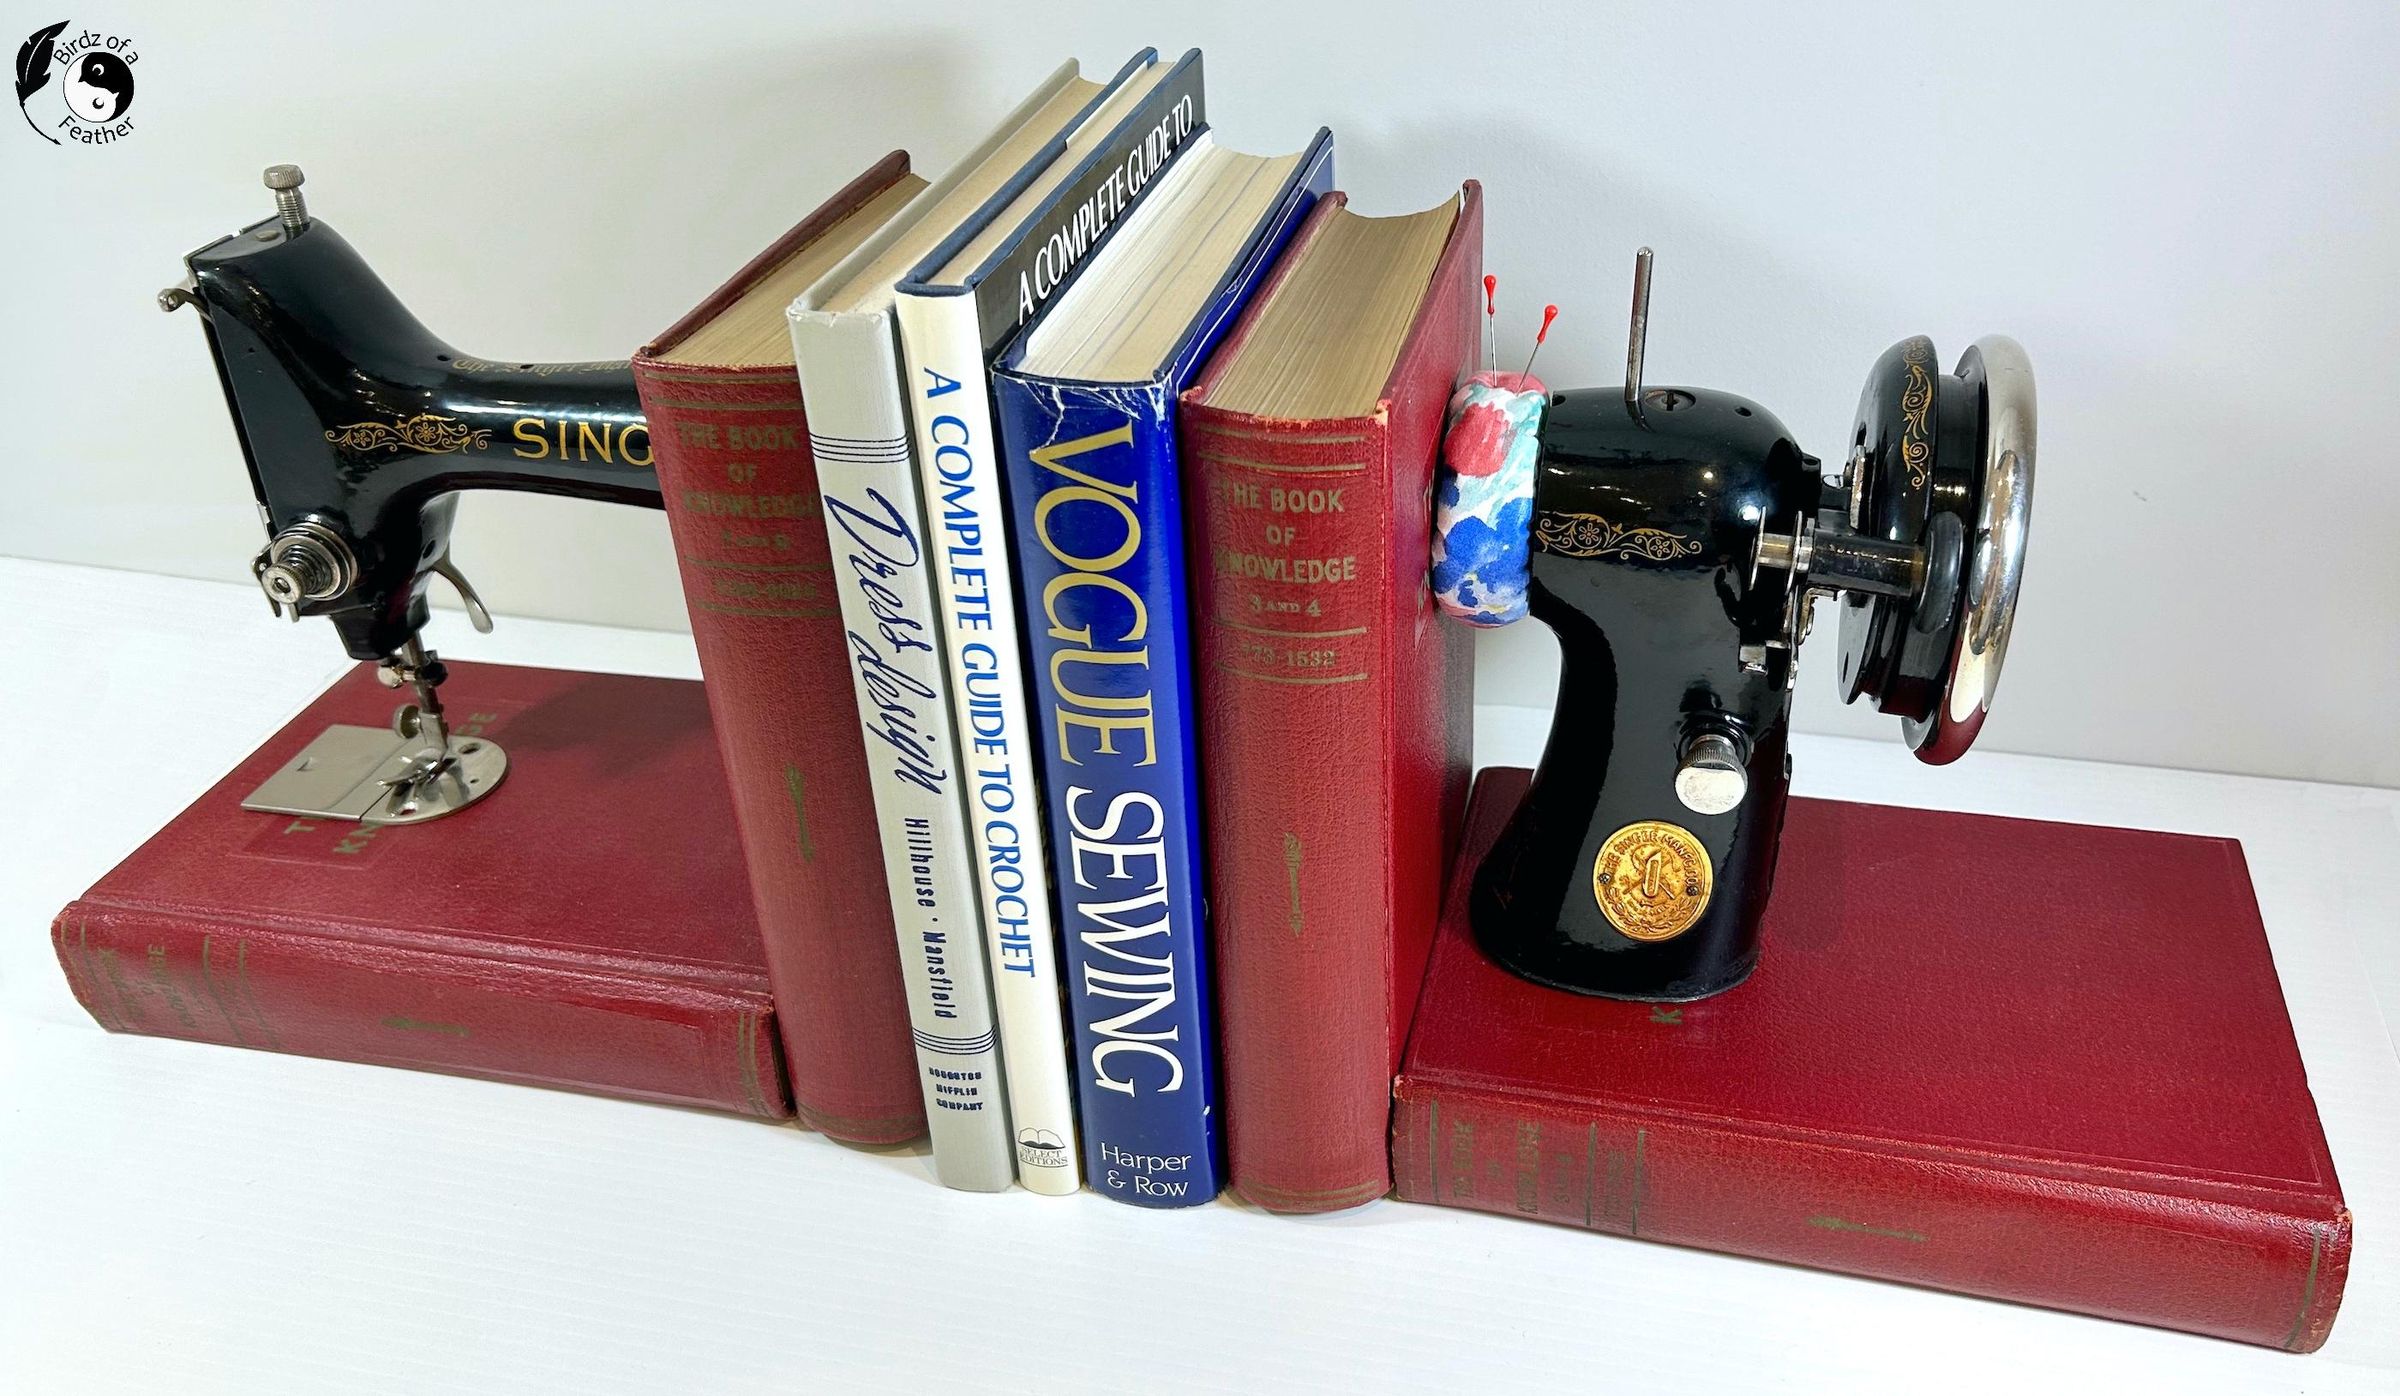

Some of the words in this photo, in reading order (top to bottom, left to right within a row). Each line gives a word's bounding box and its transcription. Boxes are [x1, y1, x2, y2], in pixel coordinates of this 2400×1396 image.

[1018, 270, 1035, 326] A
[1034, 164, 1126, 300] COMPLETE
[1127, 115, 1173, 198] GUIDE
[1171, 94, 1194, 146] TO
[924, 367, 962, 398] A
[674, 421, 720, 450] THE
[727, 425, 799, 450] BOOK
[727, 461, 758, 483] OF
[1217, 479, 1262, 509] THE
[1270, 487, 1345, 513] BOOK
[931, 415, 993, 631] COMPLETE
[1265, 524, 1296, 546] OF
[824, 487, 933, 654] Dress
[1214, 550, 1357, 584] KNOWLEDGE
[1029, 419, 1157, 767] VOGUE
[1264, 600, 1300, 613] AND
[1305, 600, 1322, 617] 4
[848, 629, 947, 795] design
[961, 642, 1008, 756] GUIDE
[977, 763, 1015, 814] TO
[904, 817, 936, 908] Hillhouse
[922, 931, 958, 1019] Mansfield
[985, 820, 1036, 978] CROCHET
[1066, 785, 1184, 1098] SEWING
[936, 1098, 983, 1111] COMPANY
[1101, 1142, 1191, 1174] Harper
[1107, 1169, 1127, 1189] &
[1135, 1175, 1189, 1196] Row
